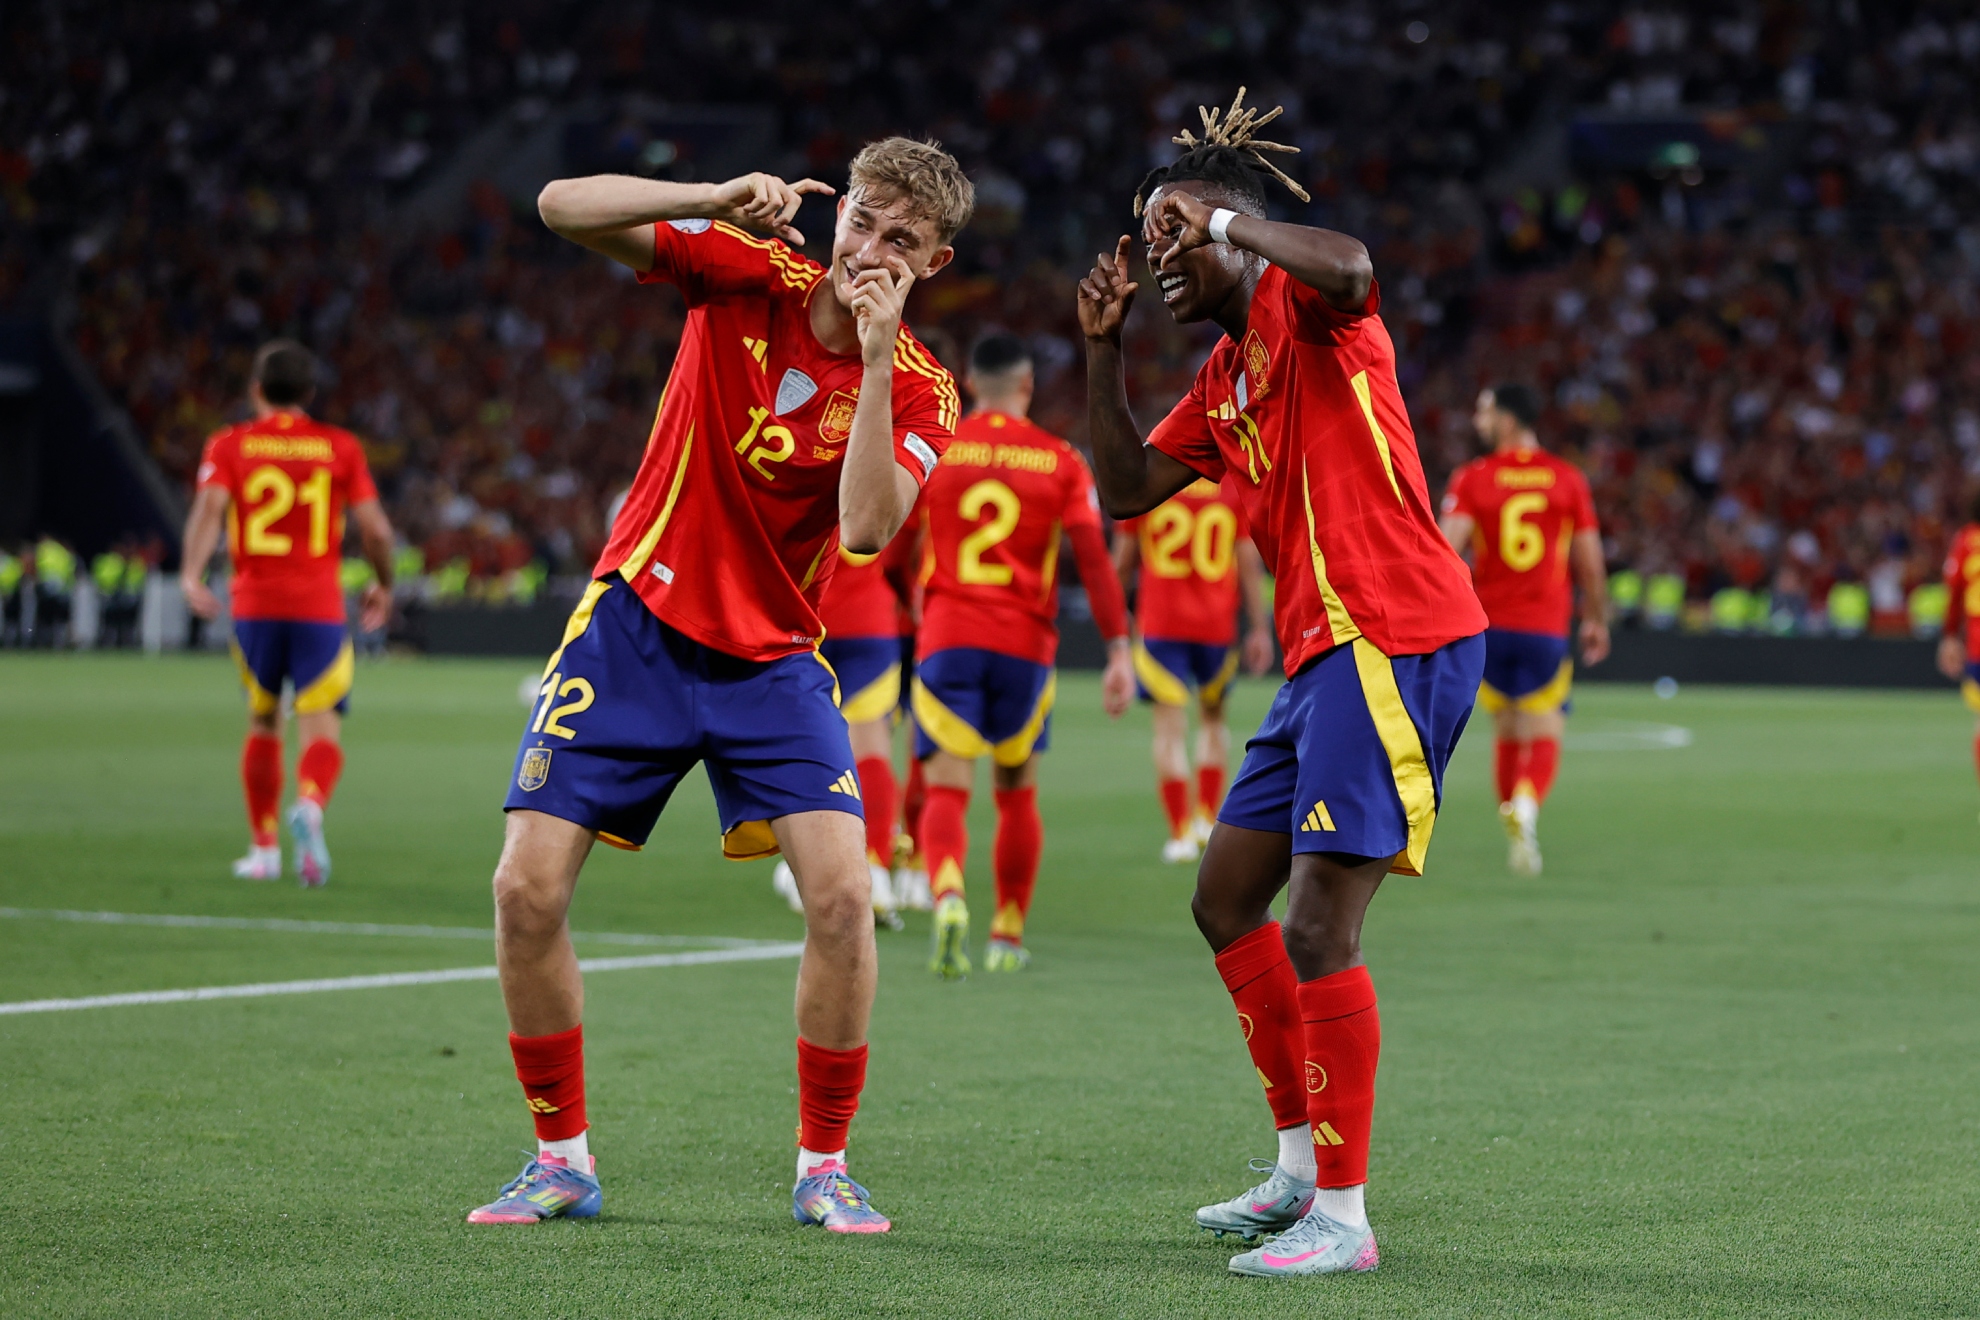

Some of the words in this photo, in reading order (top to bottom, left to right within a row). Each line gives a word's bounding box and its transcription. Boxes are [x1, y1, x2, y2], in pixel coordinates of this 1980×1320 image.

[735, 406, 796, 482] 12
[1232, 411, 1272, 485] 11
[243, 464, 332, 557] 21
[957, 478, 1021, 585] 2
[1147, 500, 1237, 583] 20
[1498, 492, 1548, 572] 6
[531, 672, 596, 741] 12
